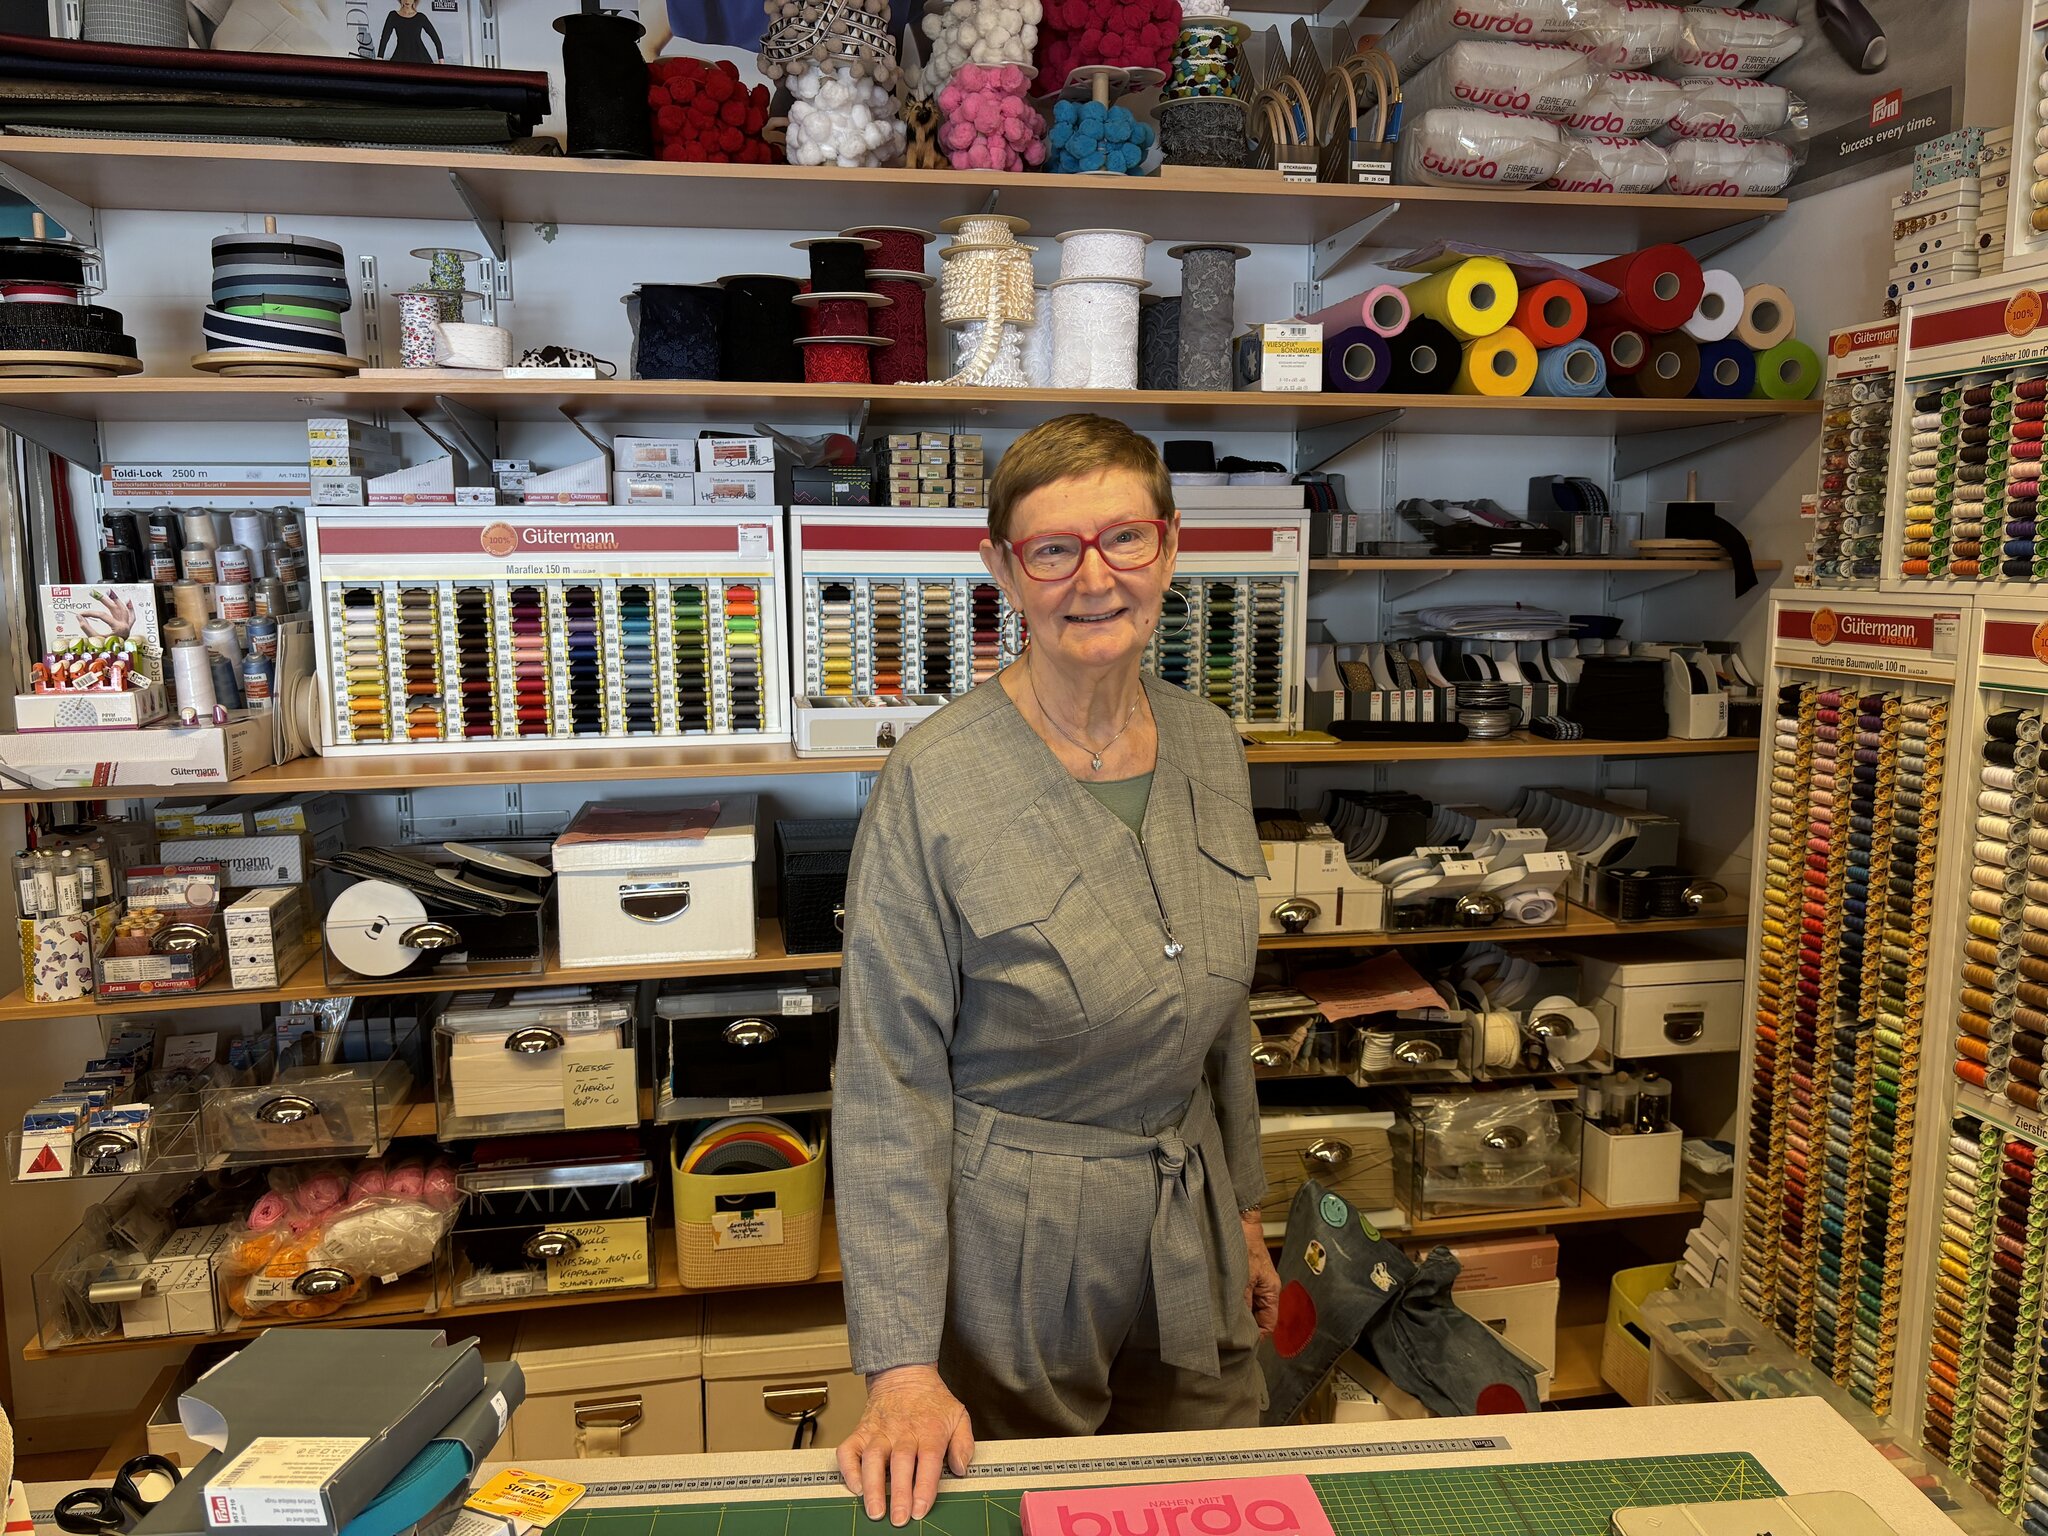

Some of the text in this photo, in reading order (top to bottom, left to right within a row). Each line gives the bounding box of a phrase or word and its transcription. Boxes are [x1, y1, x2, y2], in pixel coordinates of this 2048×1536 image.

[1452, 7, 1533, 34] burda
[1454, 80, 1531, 111] burda
[1540, 96, 1577, 107] FIBRE FILL
[1536, 102, 1568, 112] OUATINE
[1872, 97, 1899, 123] Prym
[1629, 118, 1650, 126] FIBRE
[1839, 116, 1936, 156] Success every time.
[1422, 147, 1498, 180] burda
[1506, 164, 1544, 175] FIBRE FILL
[1503, 171, 1536, 180] OUATINE
[1619, 184, 1638, 192] FIBRE
[2012, 308, 2034, 321] 100%
[1980, 351, 2016, 365] Allesnäher
[2018, 348, 2030, 359] 100
[112, 469, 162, 478] Toldi-Lock
[172, 469, 195, 478] 2500
[522, 528, 614, 544] Gütermann
[573, 541, 619, 550] creativ
[506, 564, 543, 574] Maraflex
[546, 564, 560, 574] 150
[1841, 616, 1915, 638] Gütermann
[1880, 635, 1918, 646] creativ
[1812, 655, 1845, 667] naturreine
[1846, 658, 1884, 671] Baumwolle
[1885, 660, 1898, 672] 100
[170, 767, 217, 777] Gütermann
[133, 884, 169, 896] Jeans
[154, 980, 189, 988] Gütermann
[568, 1063, 614, 1073] TRESSE
[573, 1083, 614, 1095] CHEVRON
[2015, 1115, 2048, 1139] Zierstic
[505, 1483, 554, 1501] Stretchy
[1149, 1496, 1220, 1508] NÄHEN MIT
[214, 1498, 229, 1522] Prym
[1057, 1494, 1300, 1536] burda
